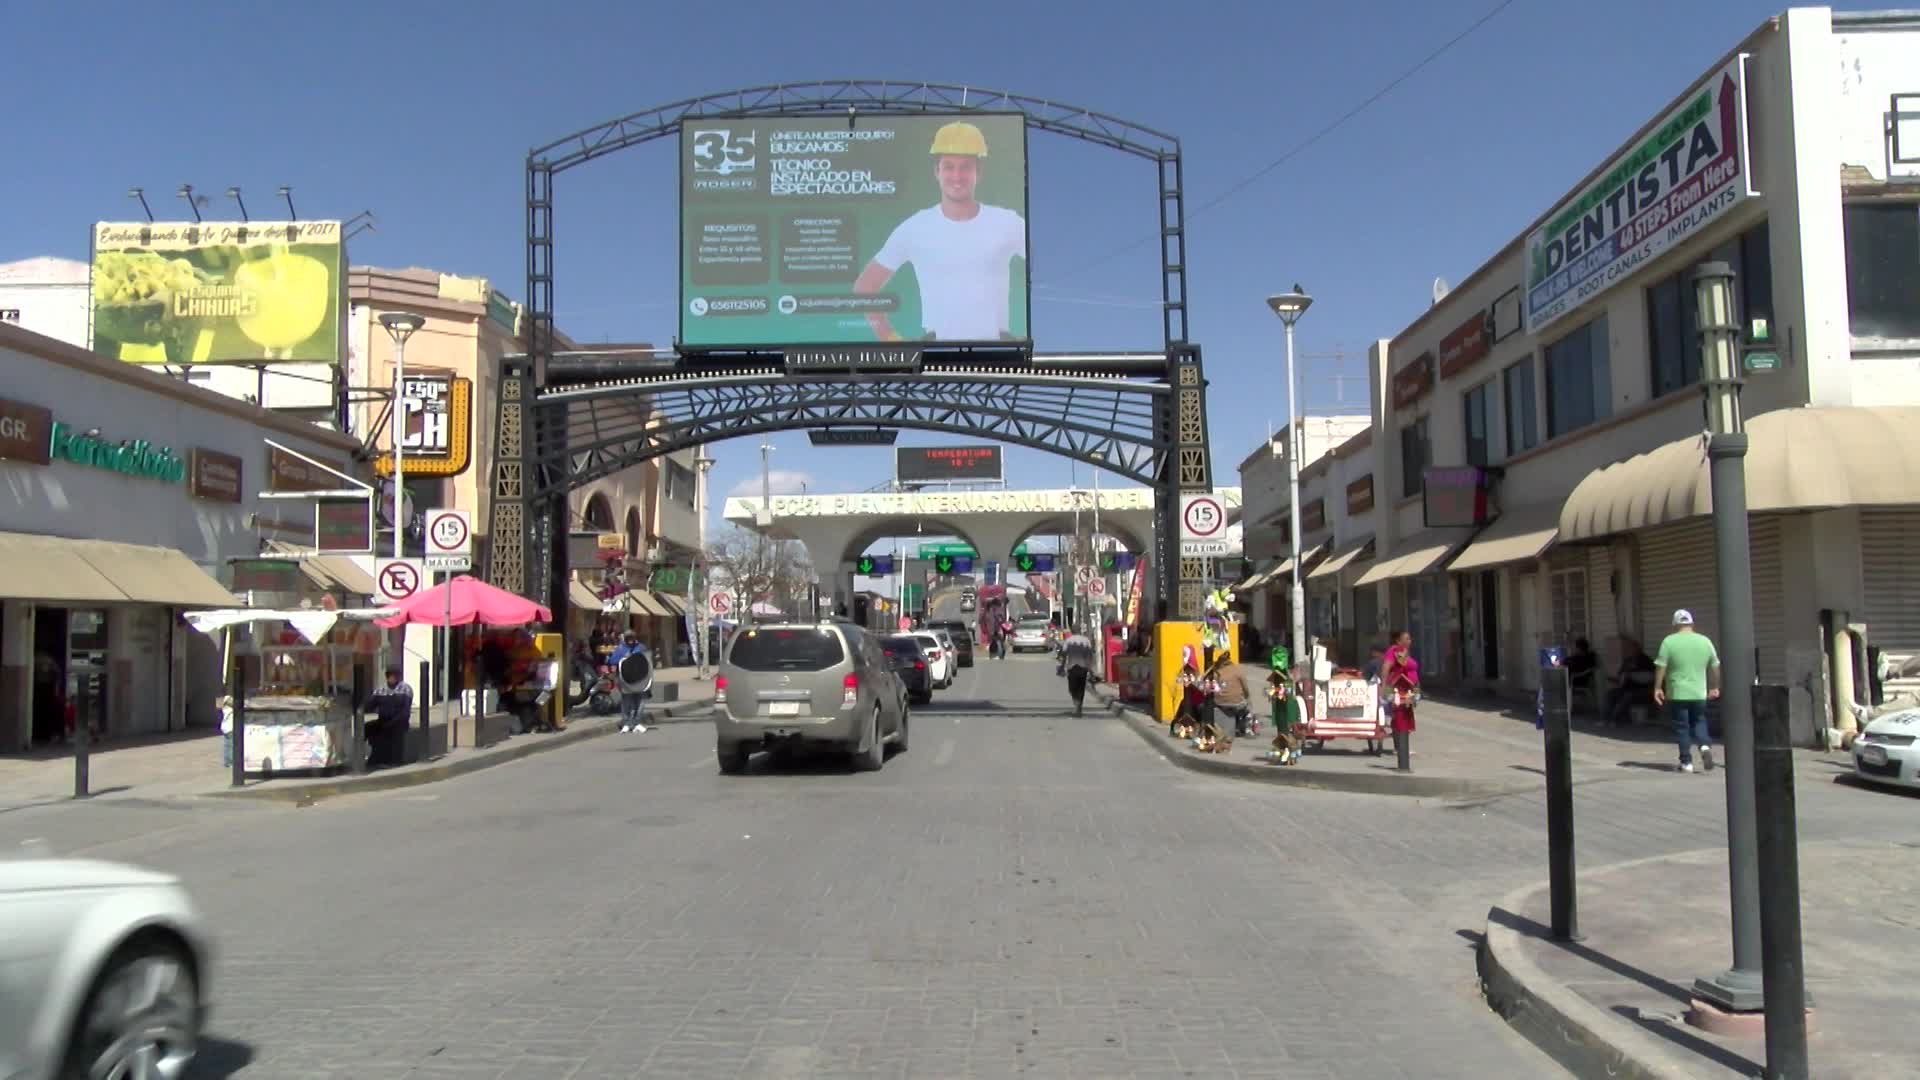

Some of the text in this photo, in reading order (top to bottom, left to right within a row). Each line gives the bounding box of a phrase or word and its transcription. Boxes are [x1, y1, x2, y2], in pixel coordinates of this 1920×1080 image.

[770, 141, 849, 154] BUSCAMOS:
[770, 170, 872, 182] INSTALADO EN
[770, 181, 896, 195] ESPECTACULARES
[1546, 120, 1719, 279] DENTISTA
[1634, 201, 1669, 242] STEPS
[1670, 180, 1701, 218] From
[1703, 156, 1735, 192] Here
[1576, 276, 1607, 299] ROOT
[1607, 243, 1652, 281] CANALS
[1666, 185, 1736, 242] IMPLANTS
[785, 353, 851, 364] CIUDAD
[834, 495, 904, 515] PUENTE
[911, 493, 1055, 515] INTERNACIONAL
[1194, 507, 1213, 521] 15
[440, 521, 459, 536] 15
[391, 571, 407, 590] E
